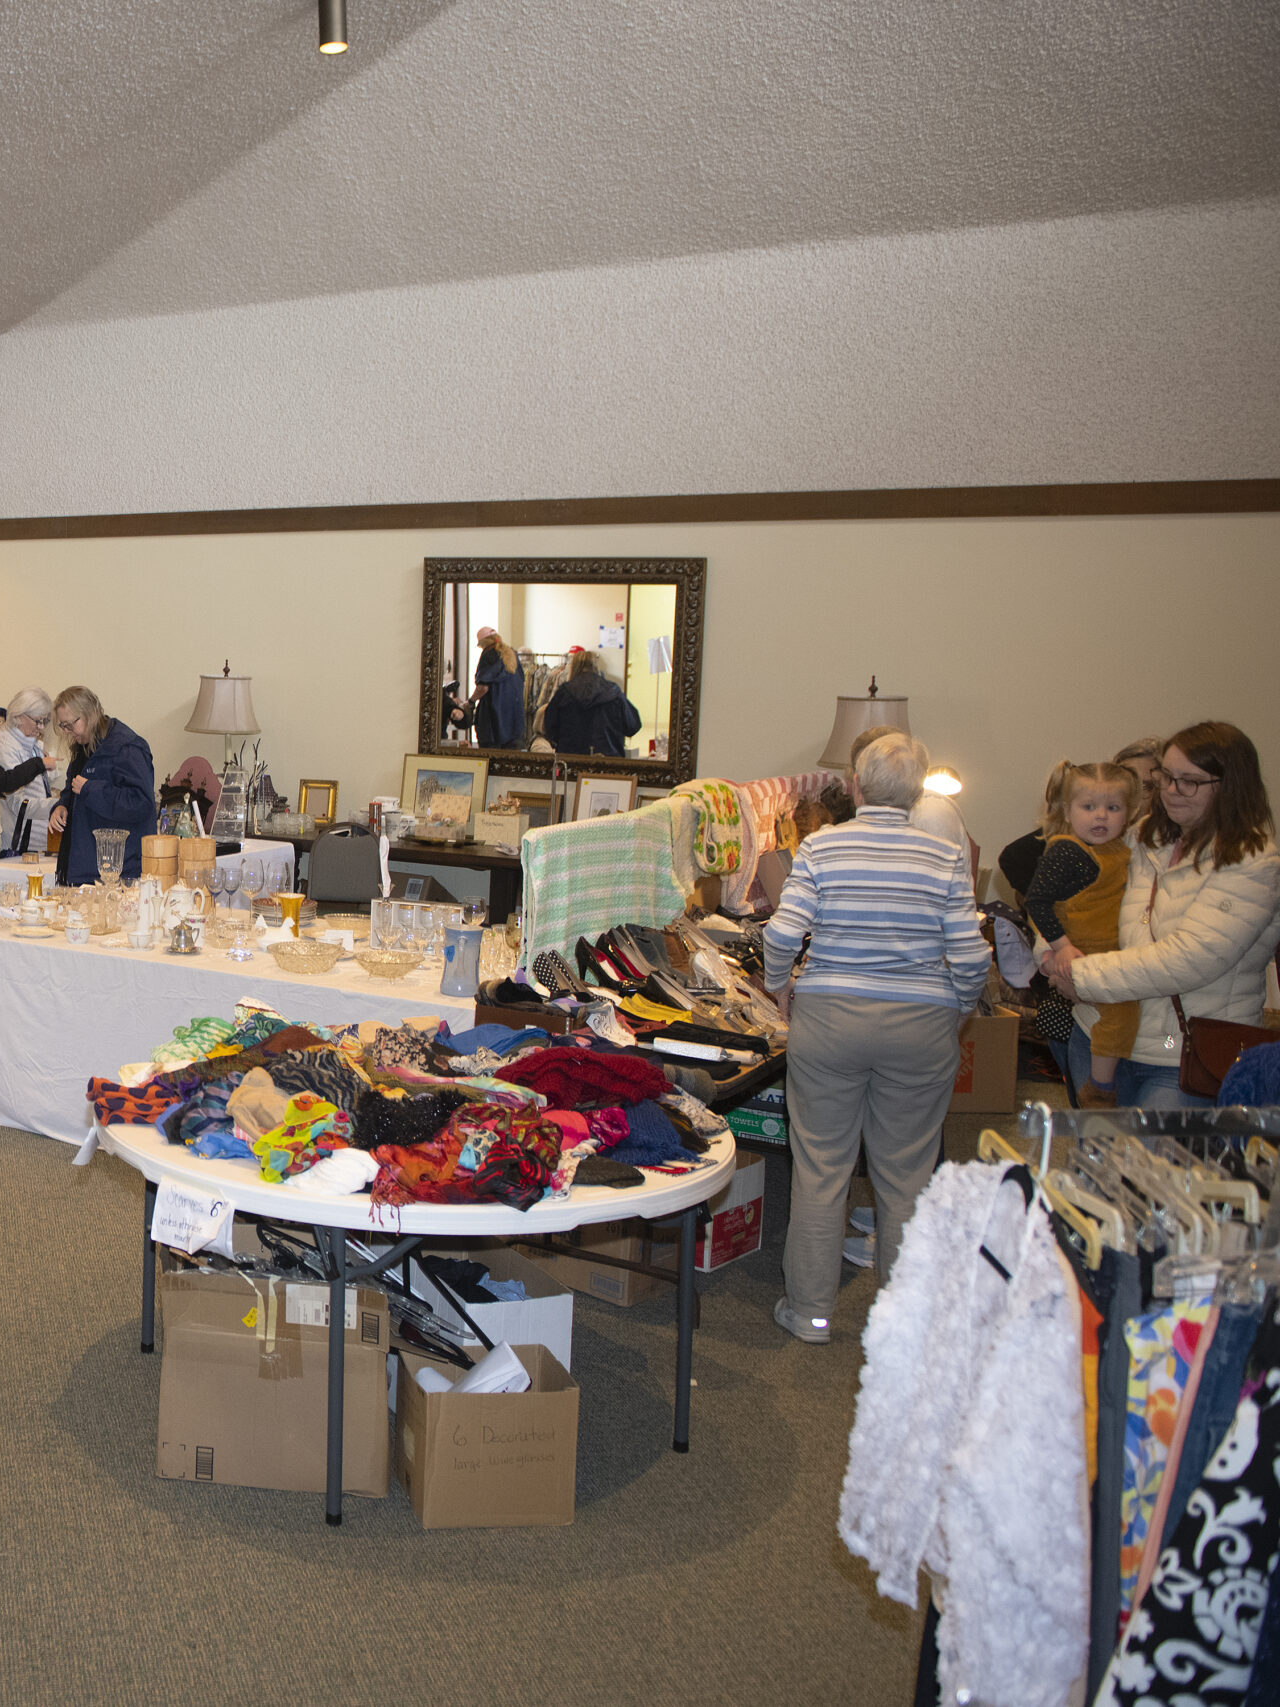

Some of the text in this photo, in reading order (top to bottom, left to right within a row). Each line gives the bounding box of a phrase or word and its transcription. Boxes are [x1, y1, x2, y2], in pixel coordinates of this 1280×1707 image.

[730, 1116, 760, 1128] TOWELS
[452, 1424, 556, 1447] 6 Decorated
